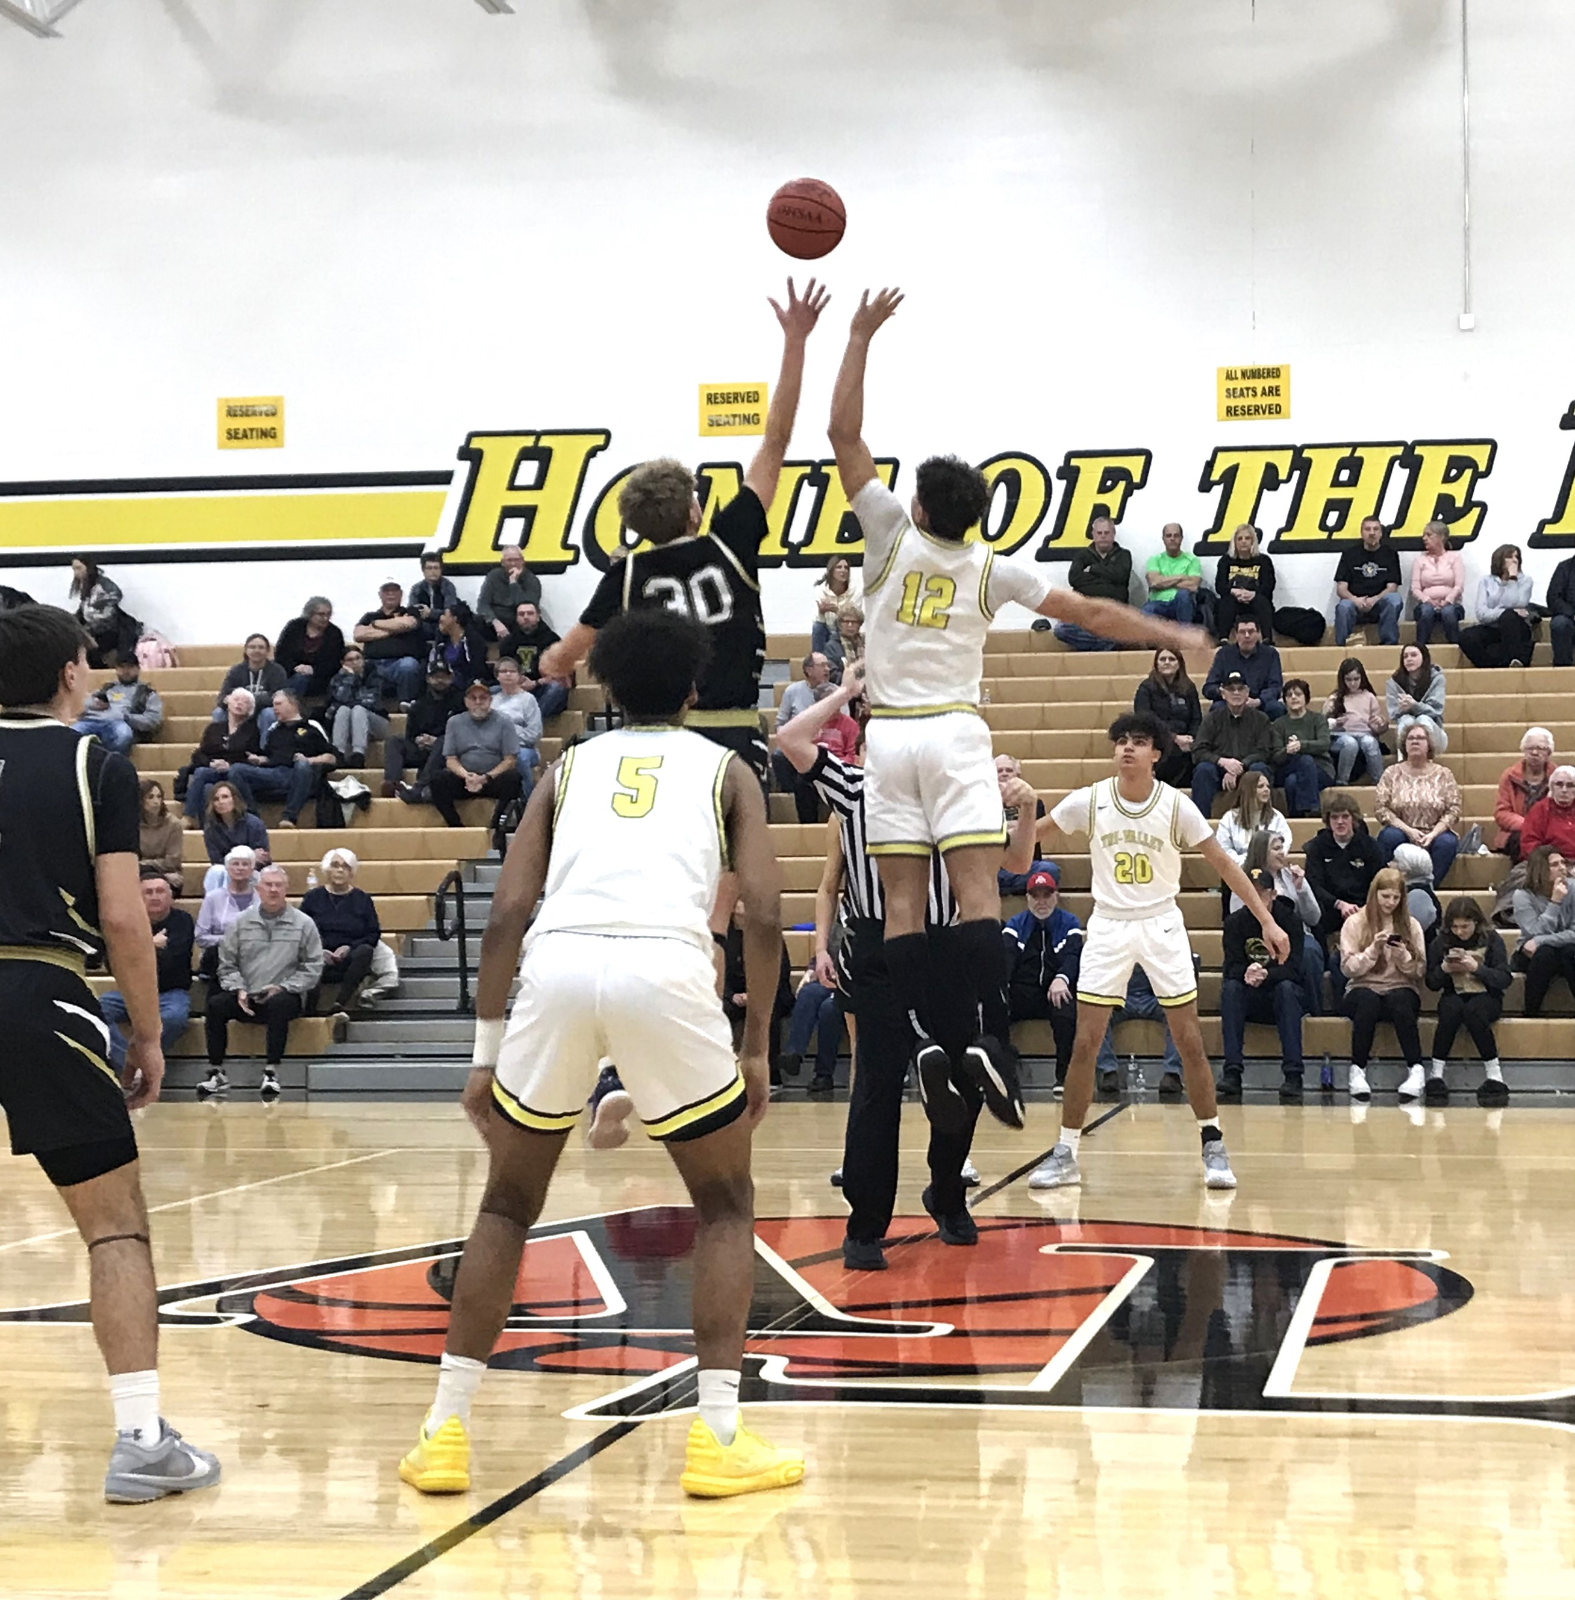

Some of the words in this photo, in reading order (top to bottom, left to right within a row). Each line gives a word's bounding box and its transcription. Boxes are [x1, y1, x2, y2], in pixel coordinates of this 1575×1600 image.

[1225, 369, 1239, 381] ALL
[1240, 367, 1281, 380] NUMBERED
[706, 390, 760, 405] RESERVED
[1225, 386, 1258, 399] SEATS
[1260, 385, 1281, 398] ARE
[1226, 403, 1282, 417] RESERVED
[707, 412, 761, 427] SEATING
[226, 426, 277, 441] SEATING
[962, 448, 1153, 562] OF
[1193, 438, 1498, 556] THE
[642, 566, 734, 626] 30
[896, 570, 957, 630] 12
[611, 755, 665, 819] 5
[1114, 851, 1154, 885] 20
